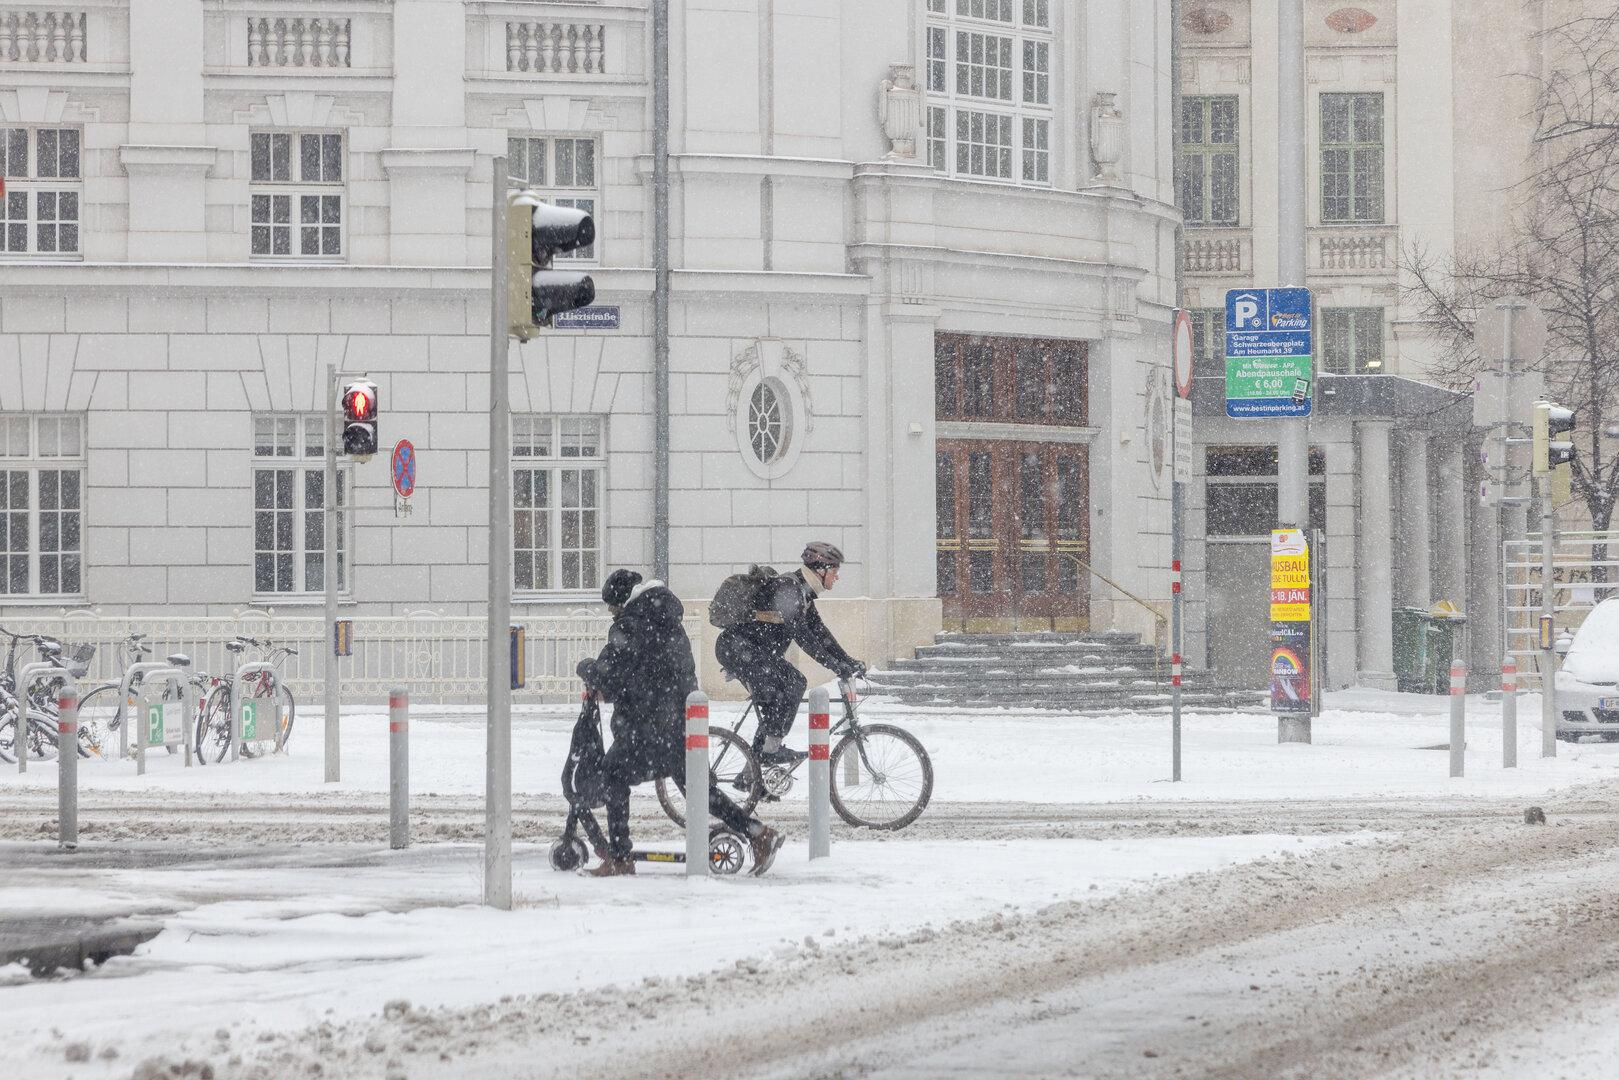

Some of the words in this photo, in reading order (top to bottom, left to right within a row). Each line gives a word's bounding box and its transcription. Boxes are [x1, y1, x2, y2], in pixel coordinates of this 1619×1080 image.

[1235, 301, 1258, 328] P
[1275, 318, 1308, 328] Parking
[1233, 340, 1305, 348] Schwarzenbergplatz
[1236, 369, 1302, 378] Abendpauschale
[1255, 380, 1261, 388] €
[1263, 379, 1283, 388] 6,00
[1232, 404, 1305, 412] www.bestinparking.at
[1282, 574, 1307, 583] TULLN
[1287, 589, 1307, 602] JÄN.
[149, 707, 159, 741] P
[242, 705, 252, 737] P
